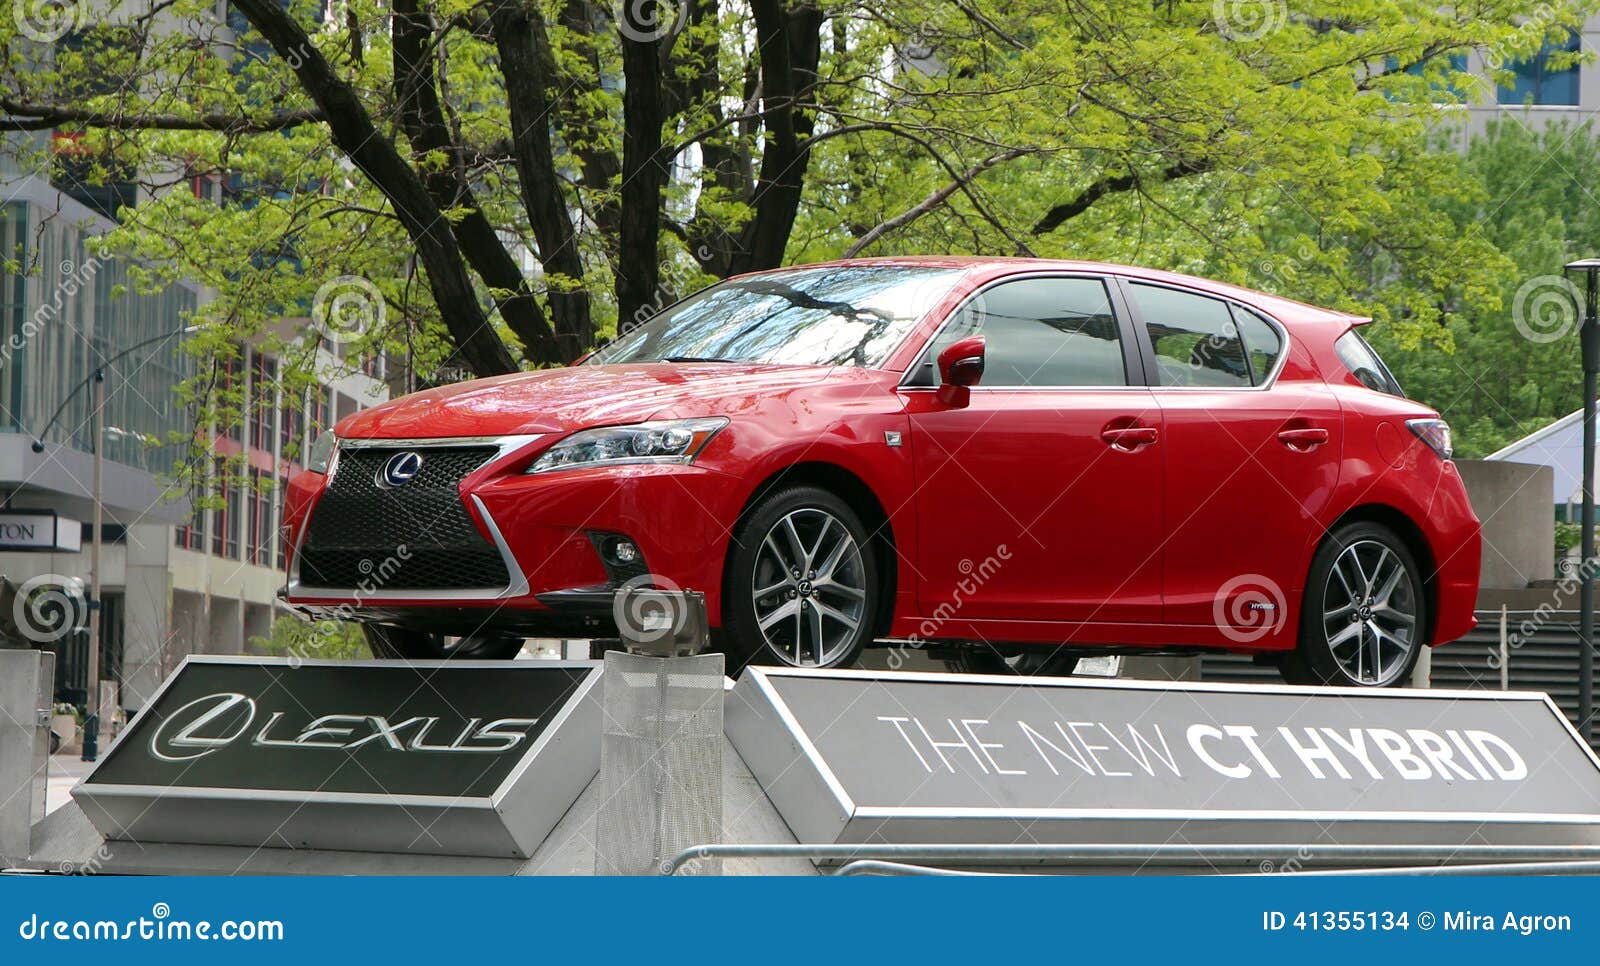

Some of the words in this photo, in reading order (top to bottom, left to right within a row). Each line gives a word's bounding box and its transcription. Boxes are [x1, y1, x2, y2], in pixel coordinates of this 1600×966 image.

[252, 712, 539, 752] LEXUS
[877, 716, 1027, 775] THE
[1017, 720, 1181, 777] NEW
[1186, 724, 1282, 779] CT
[1277, 727, 1528, 781] HYBRID
